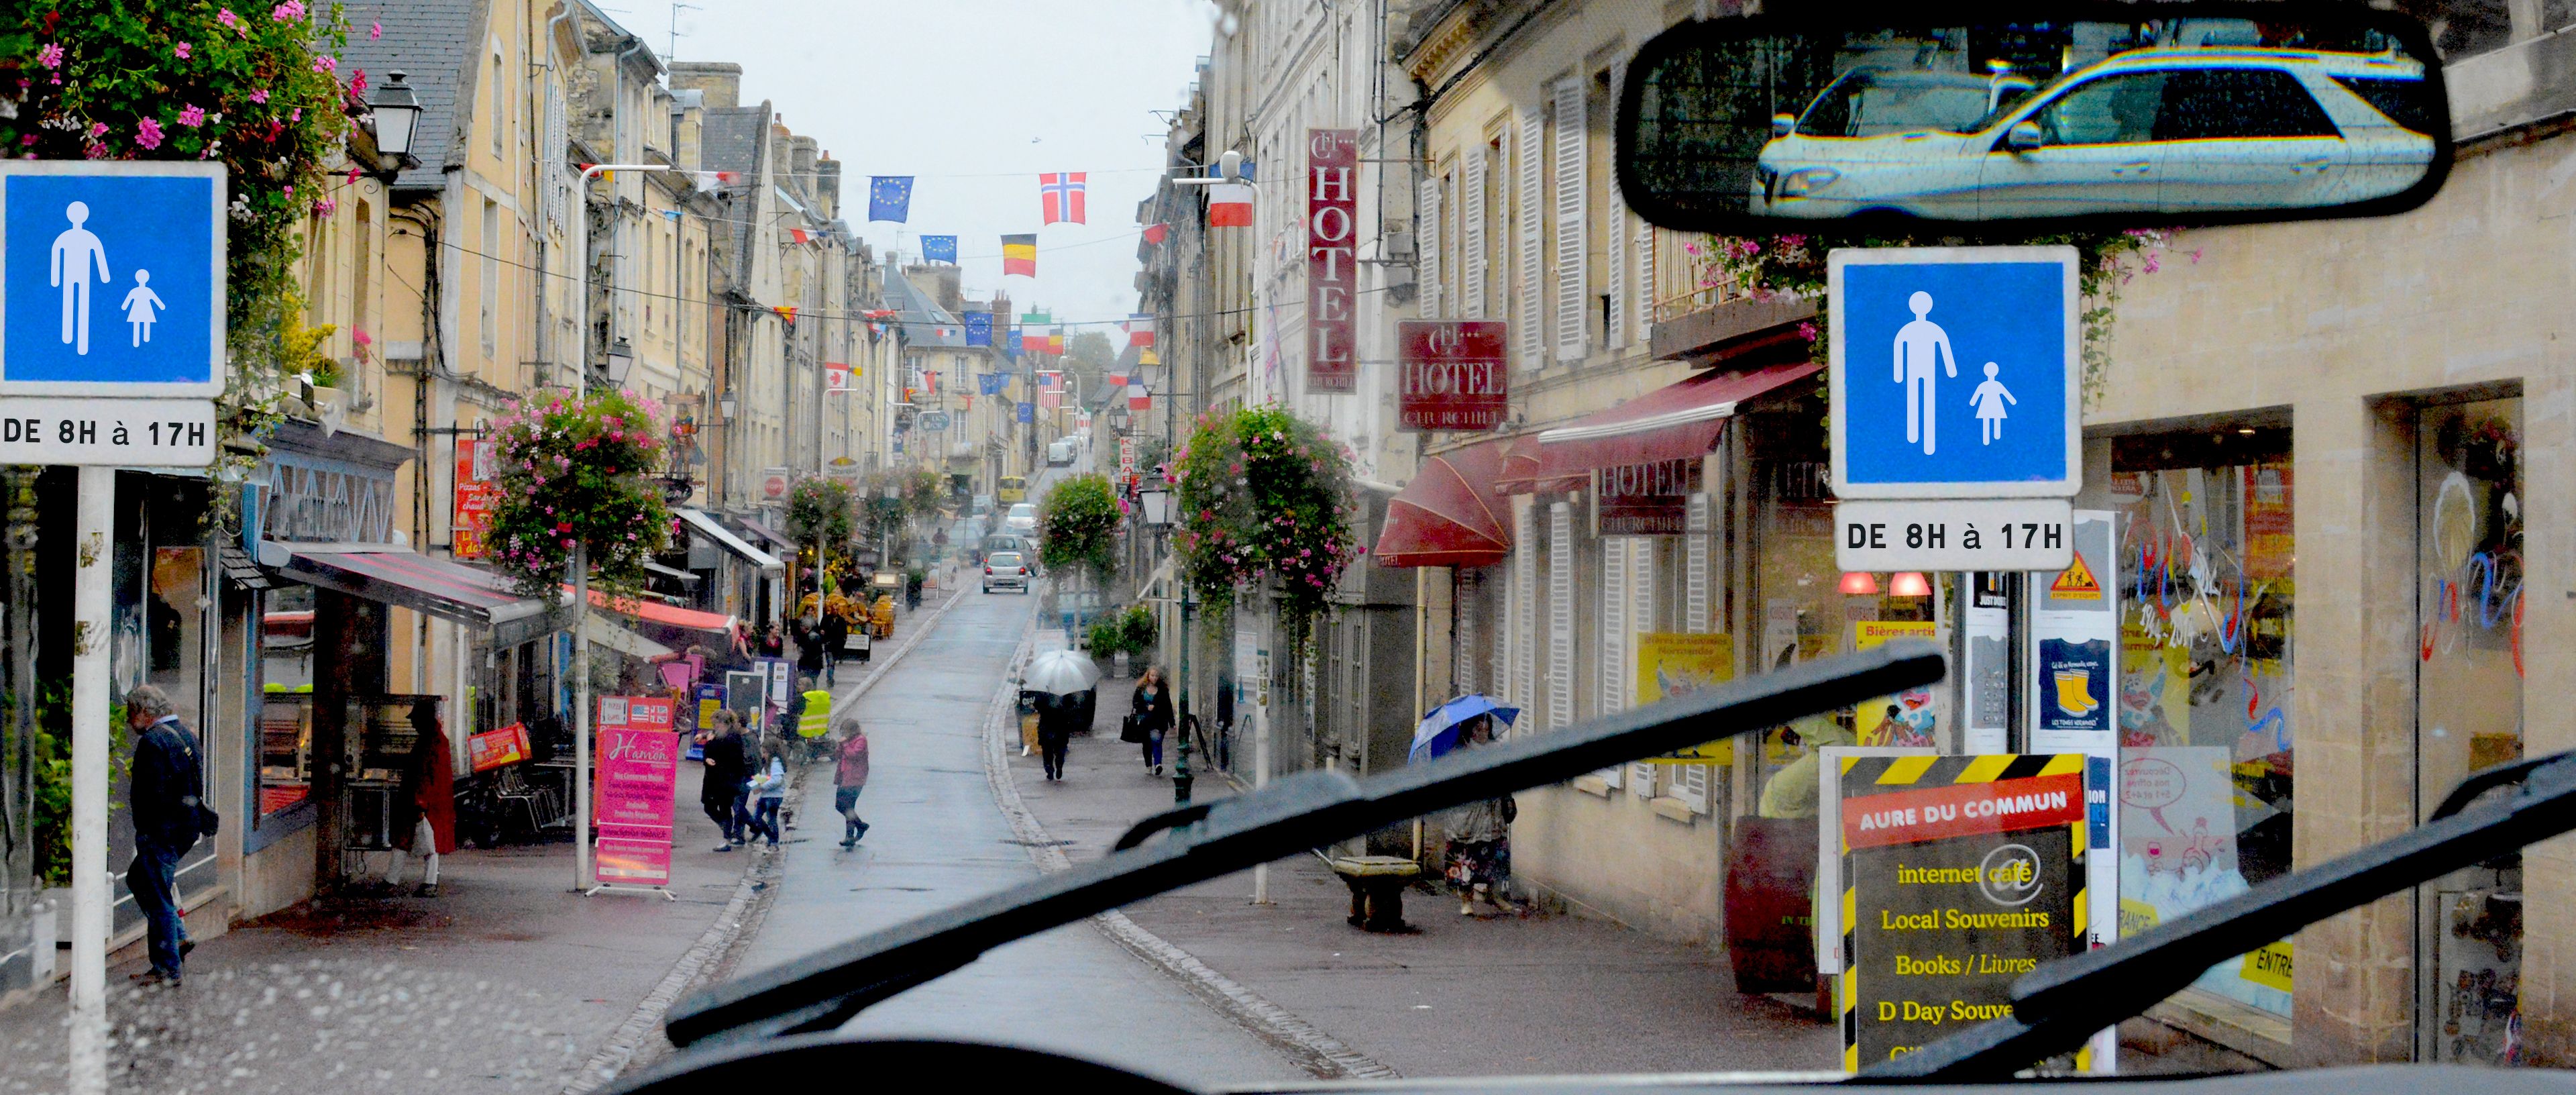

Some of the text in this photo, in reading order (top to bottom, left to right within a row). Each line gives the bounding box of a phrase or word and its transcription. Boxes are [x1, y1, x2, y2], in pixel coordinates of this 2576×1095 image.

[1311, 166, 1352, 362] HOTEL
[1404, 363, 1505, 395] HOTEL
[4, 419, 205, 446] DE 8H à 17H
[1601, 459, 1686, 497] HOTEL
[1848, 523, 1886, 549] DE
[1906, 523, 1945, 549] 8H
[1964, 523, 1982, 550] à
[2001, 523, 2061, 549] 17H
[1866, 625, 1905, 637] Bières
[1860, 808, 1917, 831] AURE
[1924, 804, 1956, 823] DU
[1964, 791, 2067, 818] COMMUN
[1898, 862, 2032, 884] internet café
[1881, 908, 2049, 930] Local Souvenirs
[1895, 955, 1961, 975] Books
[1979, 953, 2037, 973] Livres
[1879, 1000, 2014, 1025] D Day Souve
